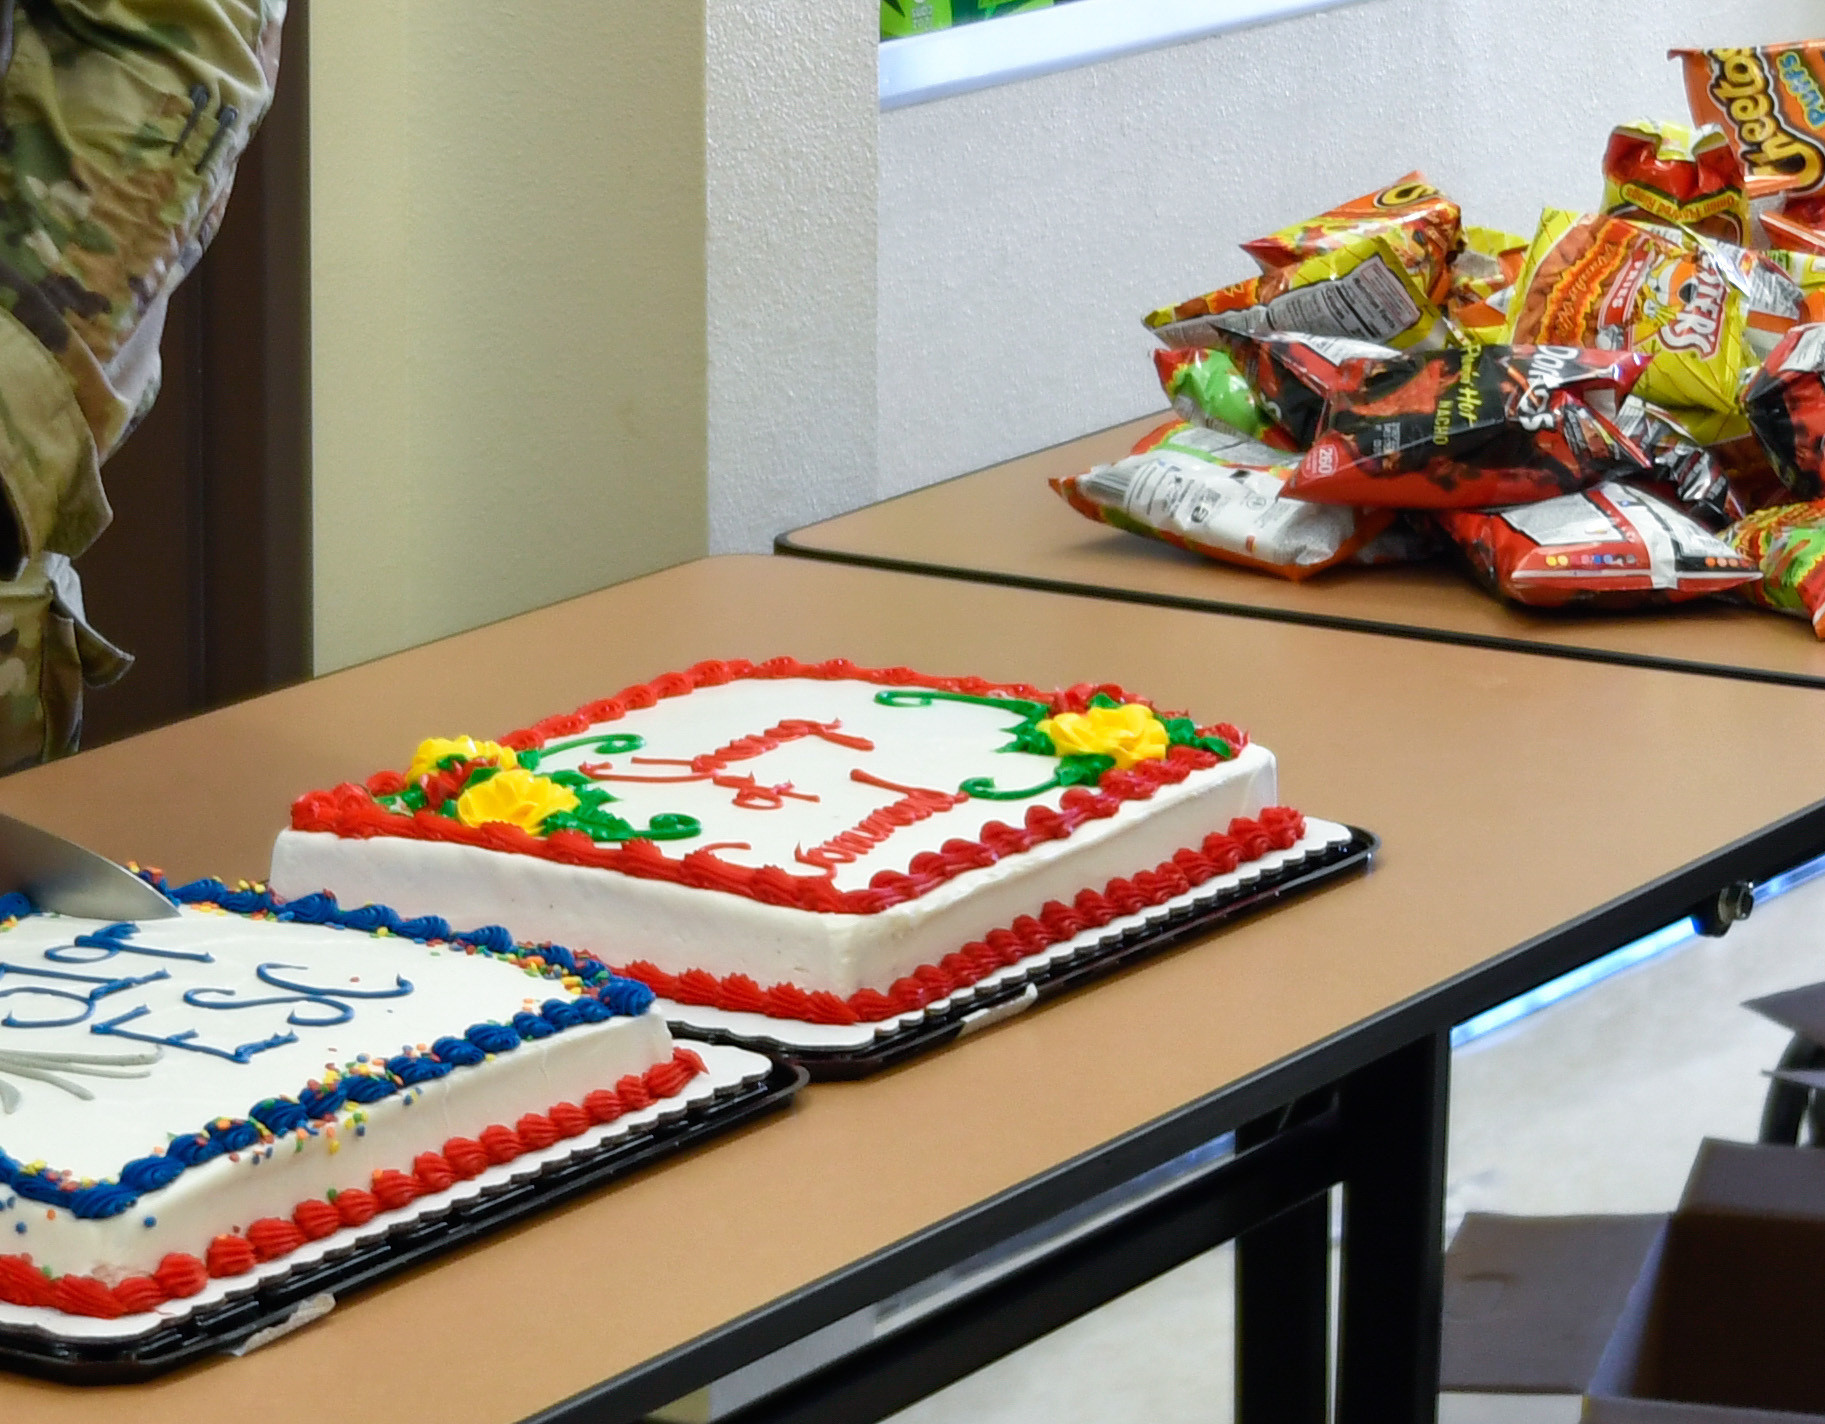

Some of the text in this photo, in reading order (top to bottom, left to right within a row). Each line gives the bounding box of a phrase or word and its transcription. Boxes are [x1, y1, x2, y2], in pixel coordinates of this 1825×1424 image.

[1658, 248, 1721, 354] STER'S
[1433, 400, 1455, 445] NACHO
[1456, 387, 1483, 427] Hot
[1317, 448, 1334, 475] 260
[89, 961, 415, 1064] ESC
